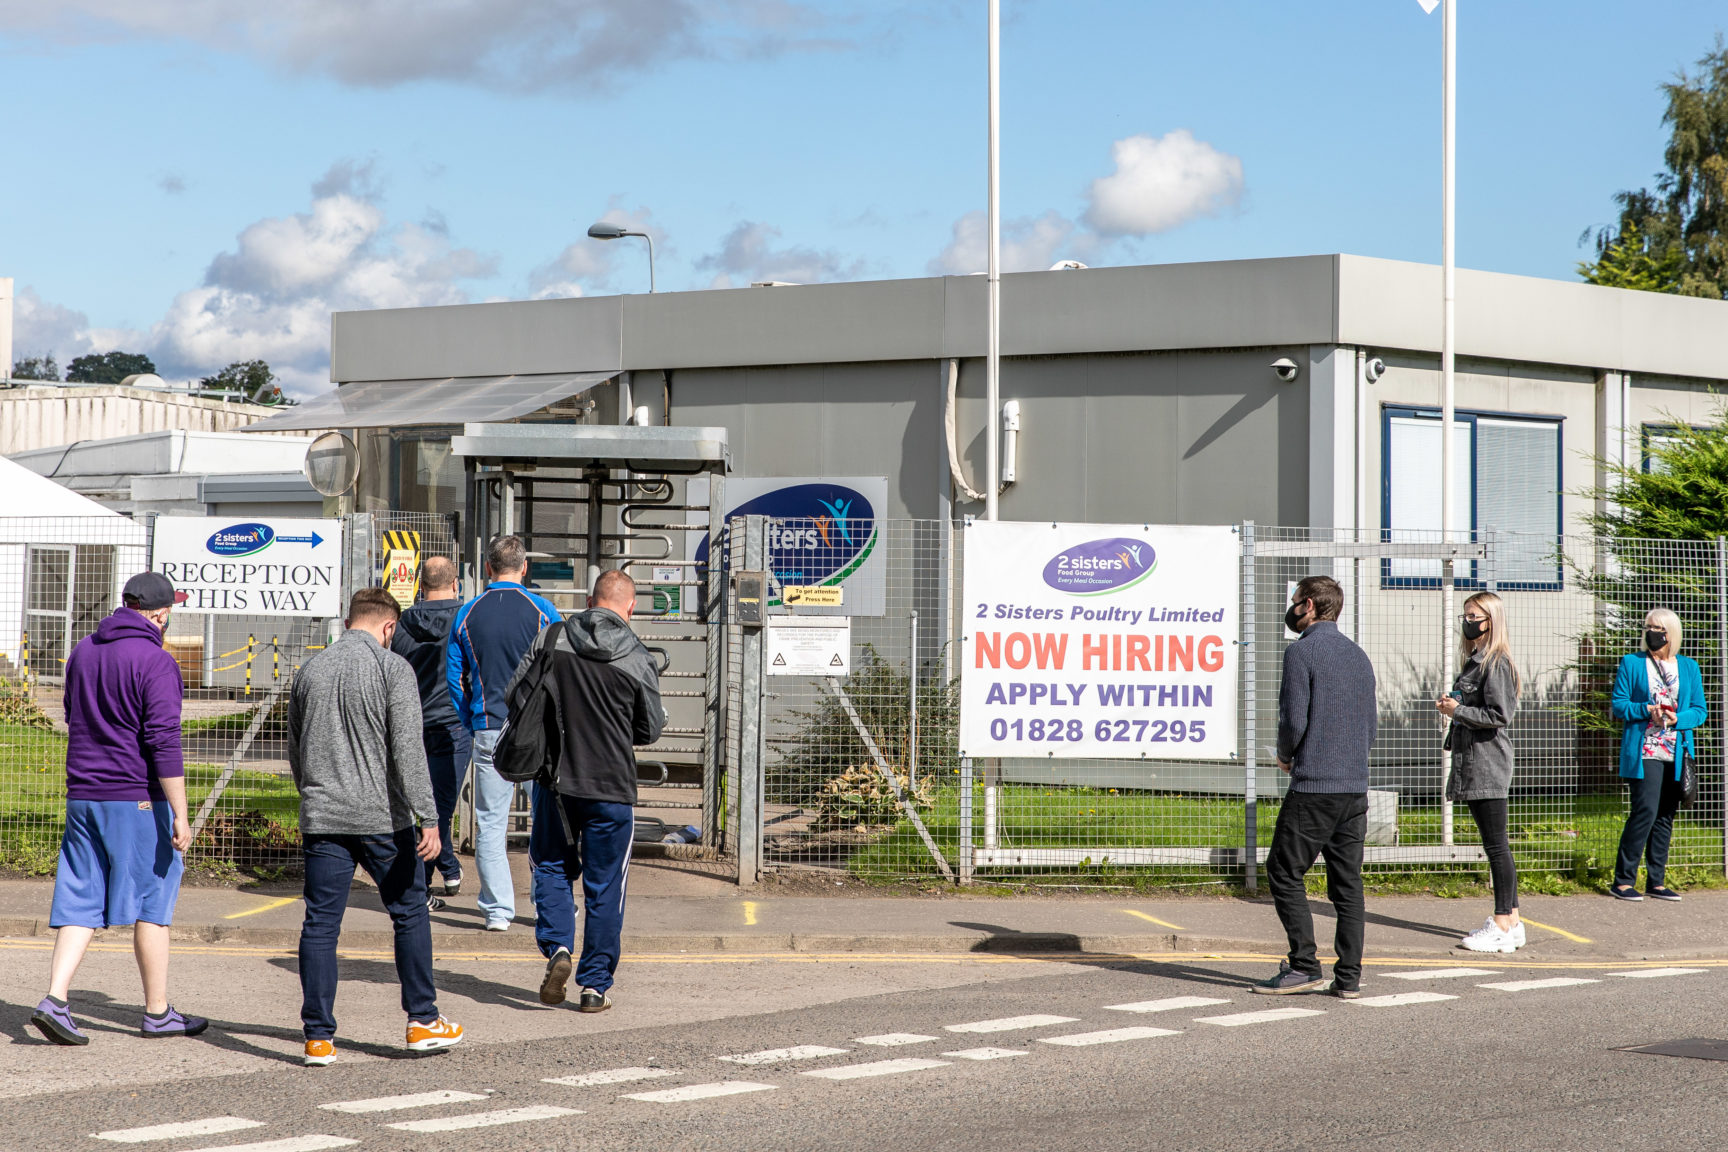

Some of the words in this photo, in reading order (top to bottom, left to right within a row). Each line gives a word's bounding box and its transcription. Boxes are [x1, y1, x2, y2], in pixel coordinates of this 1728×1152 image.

[215, 533, 222, 542] 2
[223, 533, 254, 543] sisters
[160, 562, 334, 586] RECEPTION
[1058, 555, 1069, 569] 2
[1071, 555, 1123, 570] sisters
[1075, 569, 1095, 577] Group
[176, 588, 248, 610] THIS
[259, 590, 317, 611] WAY
[976, 603, 988, 619] 2
[994, 604, 1064, 621] Sisters
[1070, 605, 1143, 625] Poultry
[1148, 607, 1225, 623] Limited
[975, 631, 1069, 670] NOW
[1082, 633, 1225, 673] HIRING
[985, 682, 1088, 706] APPLY
[1097, 684, 1213, 707] WITHIN
[990, 718, 1084, 742] 01828
[1094, 720, 1206, 743] 627295
